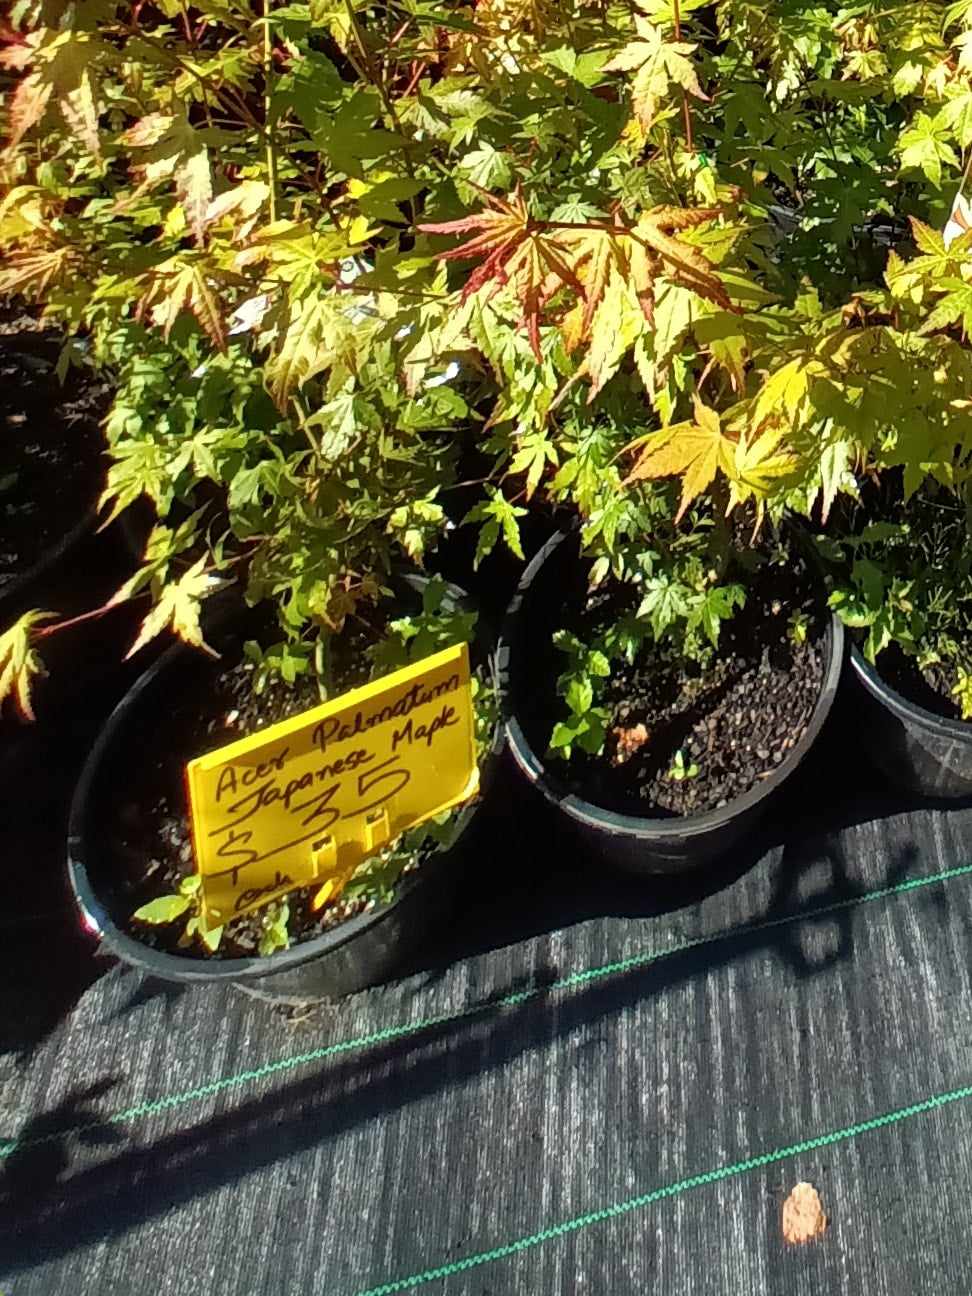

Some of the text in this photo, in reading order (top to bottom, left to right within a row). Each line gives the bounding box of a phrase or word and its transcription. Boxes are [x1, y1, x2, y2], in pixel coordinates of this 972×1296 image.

[208, 705, 460, 837] Japanese Maple
[216, 675, 460, 802] Acer Palmatum
